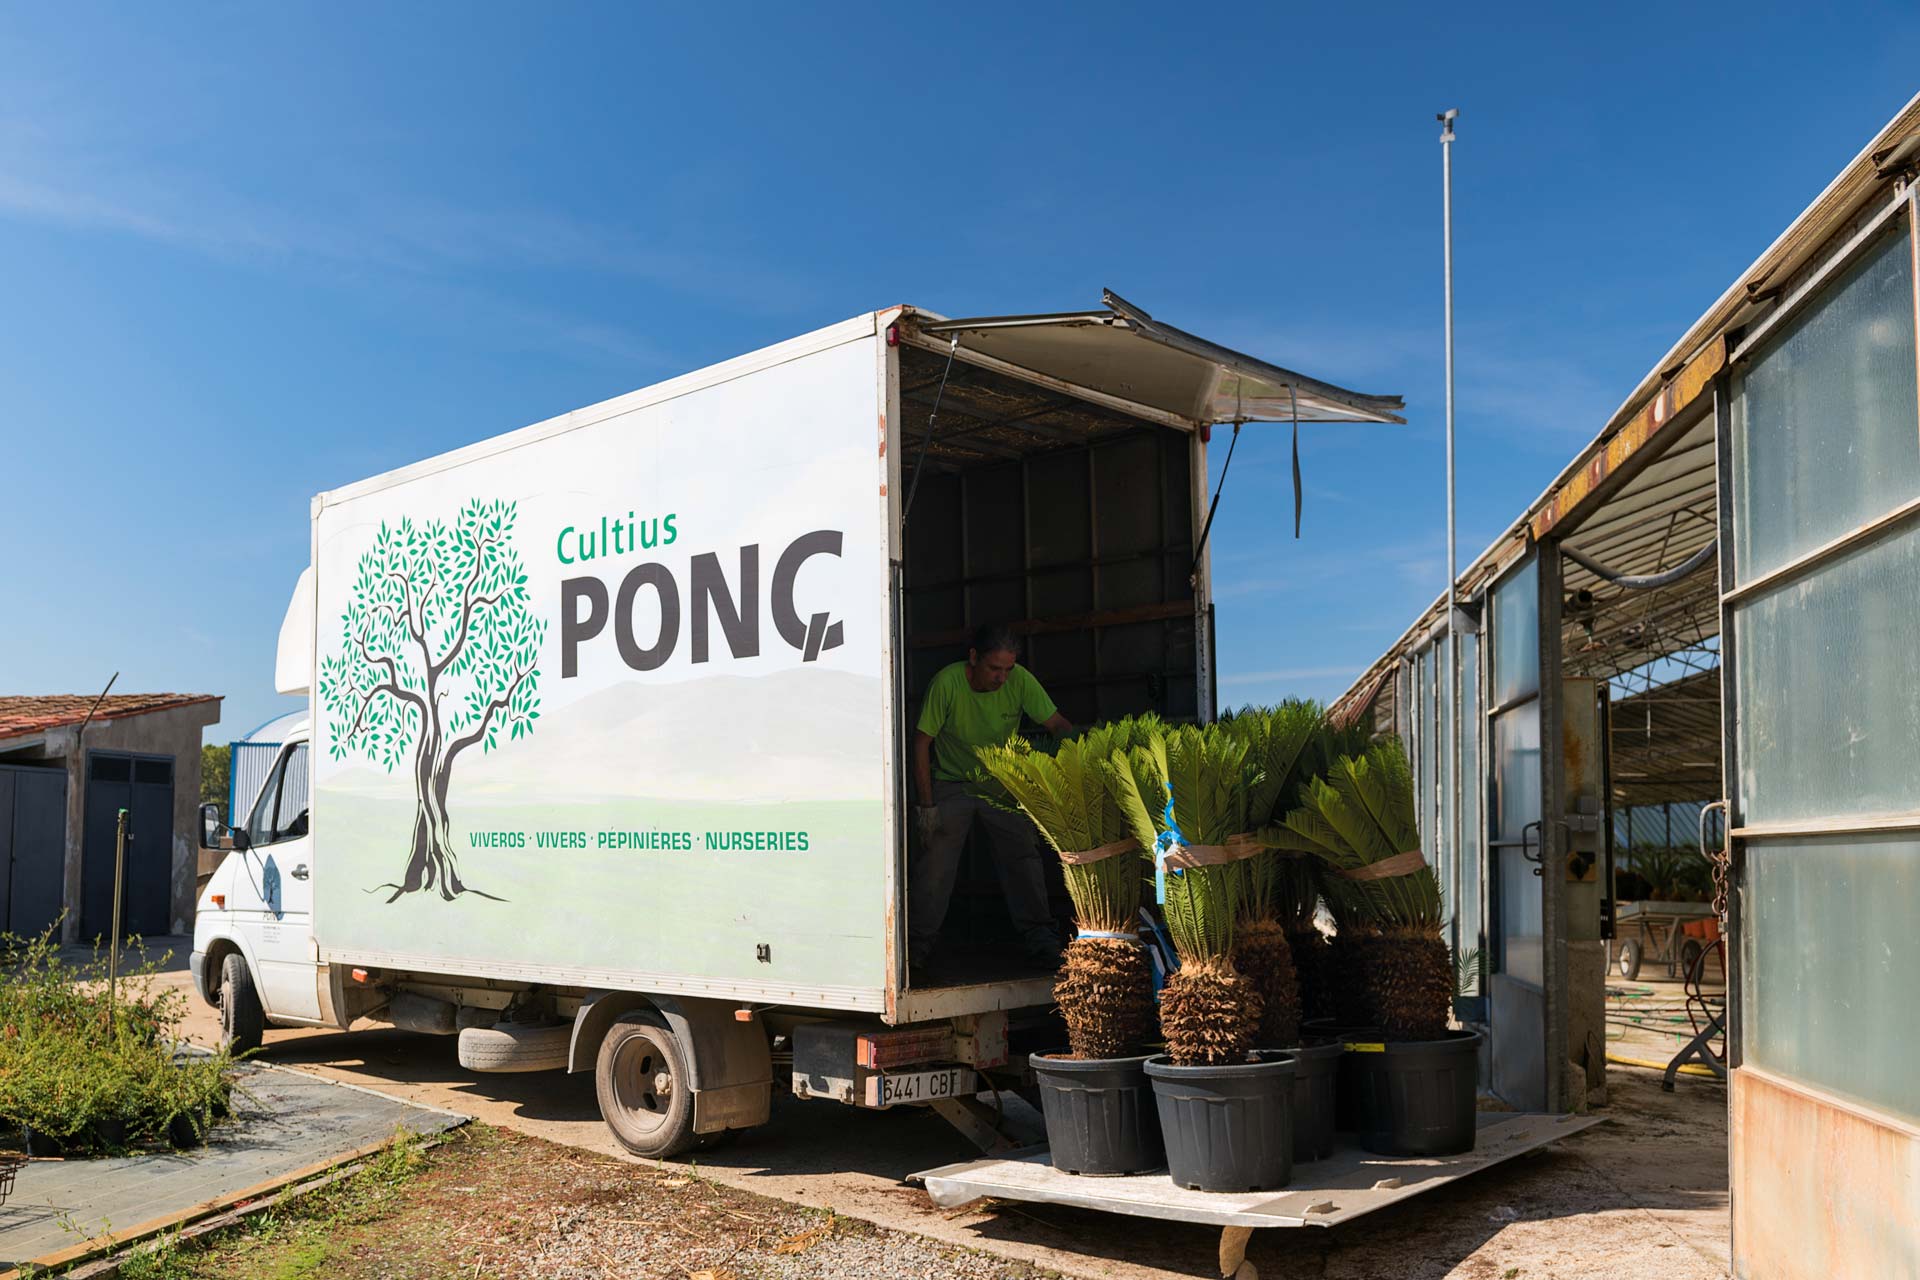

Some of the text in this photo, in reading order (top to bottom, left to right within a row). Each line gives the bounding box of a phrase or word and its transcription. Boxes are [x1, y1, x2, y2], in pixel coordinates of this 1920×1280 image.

[557, 511, 678, 565] Cultius
[561, 529, 844, 679] PONÇ
[469, 826, 809, 852] VIVEROS VIVERS PÉPINIÈRES NURSERIES
[884, 1076, 920, 1101] 6441
